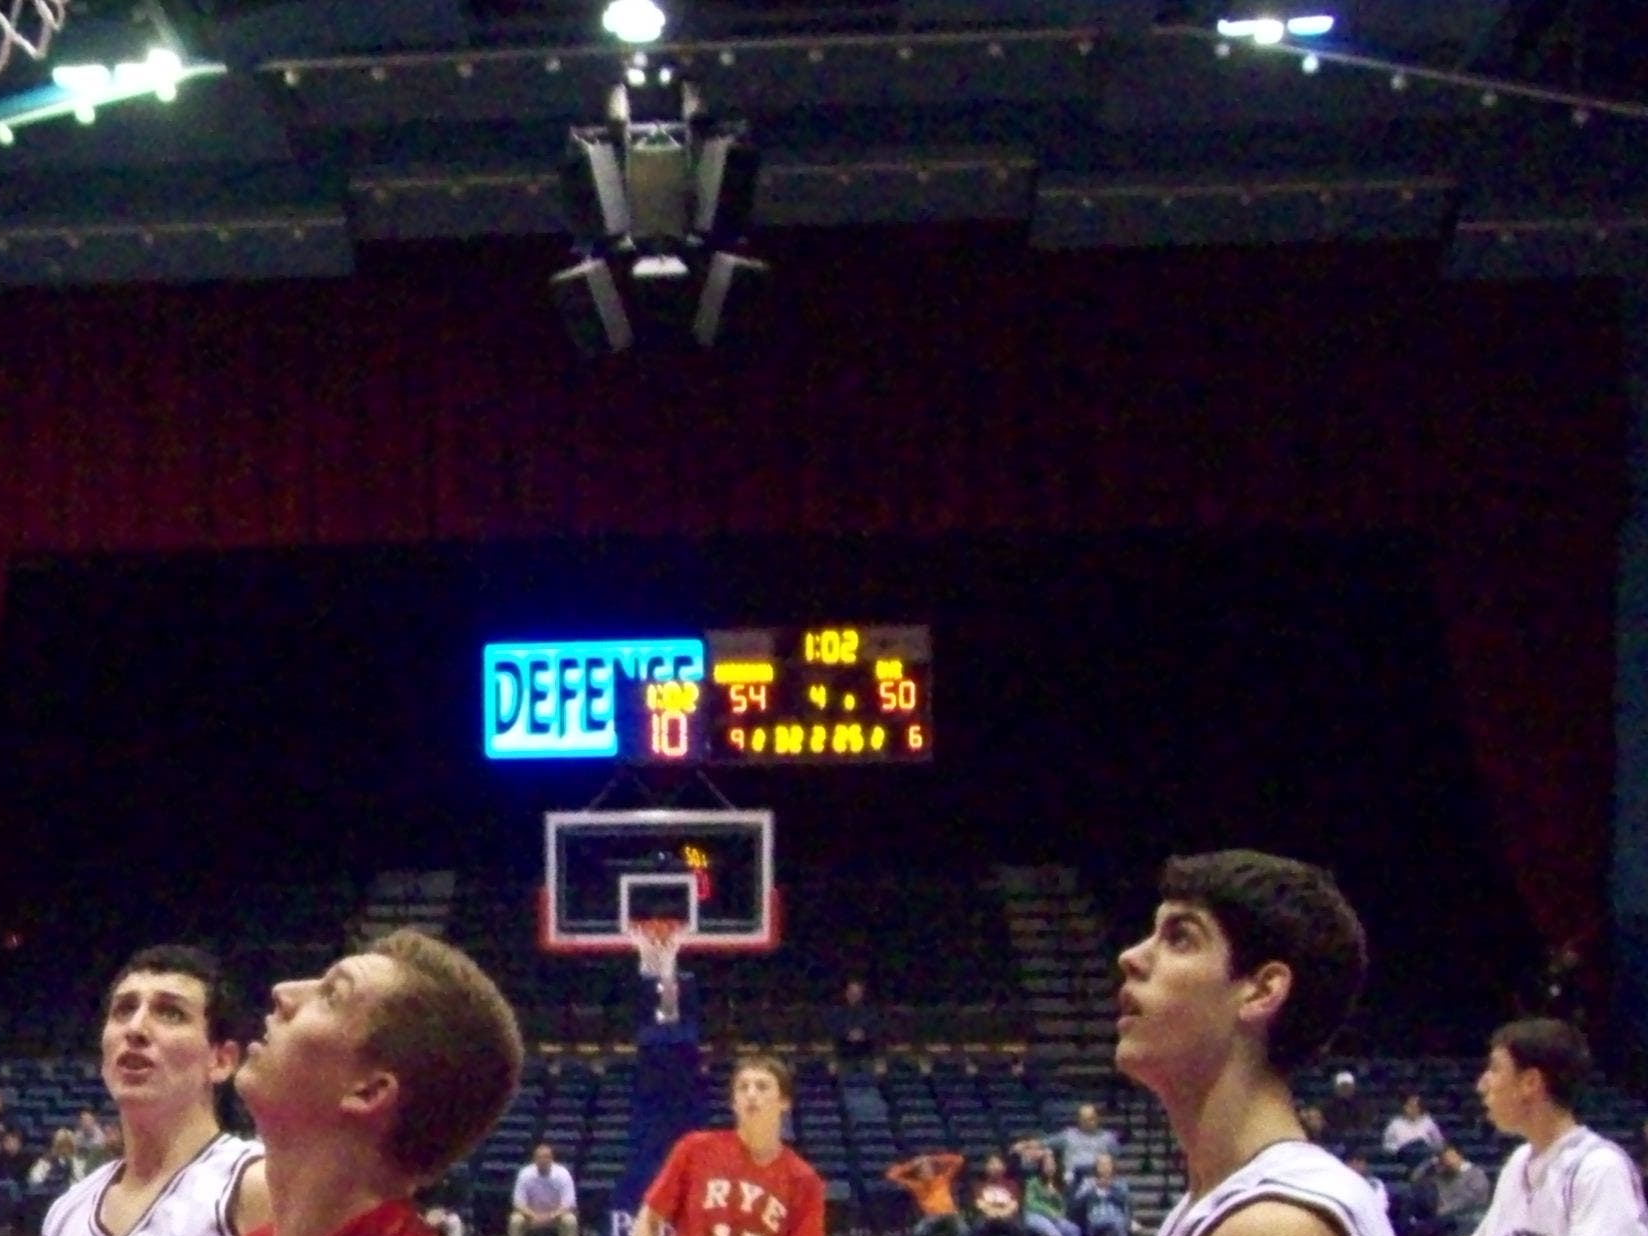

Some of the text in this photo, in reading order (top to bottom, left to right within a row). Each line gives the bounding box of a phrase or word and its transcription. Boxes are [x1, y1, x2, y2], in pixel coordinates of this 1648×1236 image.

[805, 629, 859, 664] 1:02
[730, 684, 767, 713] 54
[879, 680, 917, 712] 50
[652, 711, 688, 757] 10
[730, 727, 745, 750] 9
[908, 724, 923, 750] 6
[704, 1178, 788, 1233] RYE
